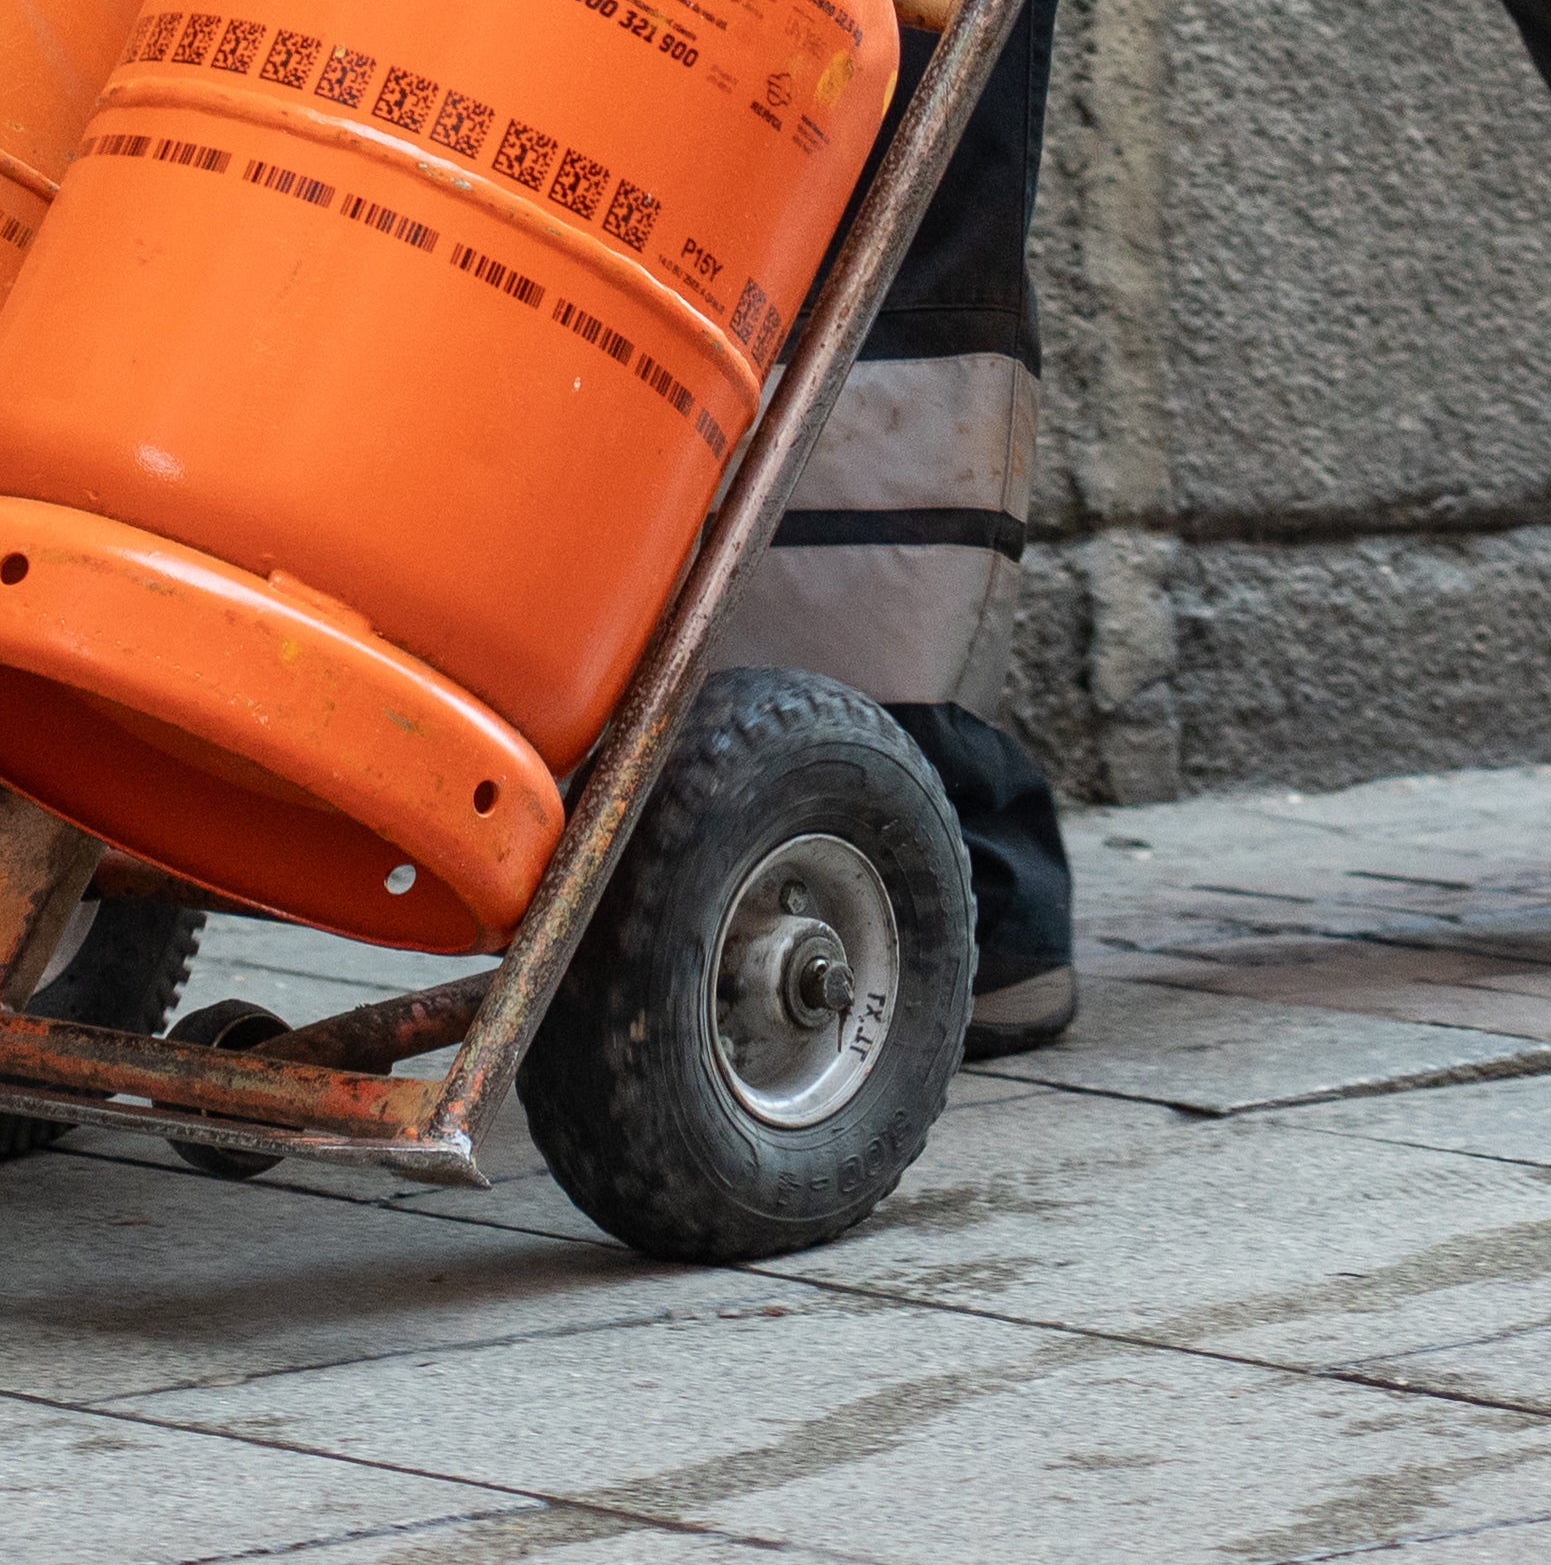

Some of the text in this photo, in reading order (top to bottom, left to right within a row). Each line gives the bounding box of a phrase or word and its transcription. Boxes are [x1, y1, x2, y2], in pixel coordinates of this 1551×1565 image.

[619, 10, 656, 43] 321
[659, 34, 698, 67] 900
[680, 237, 724, 283] P15Y
